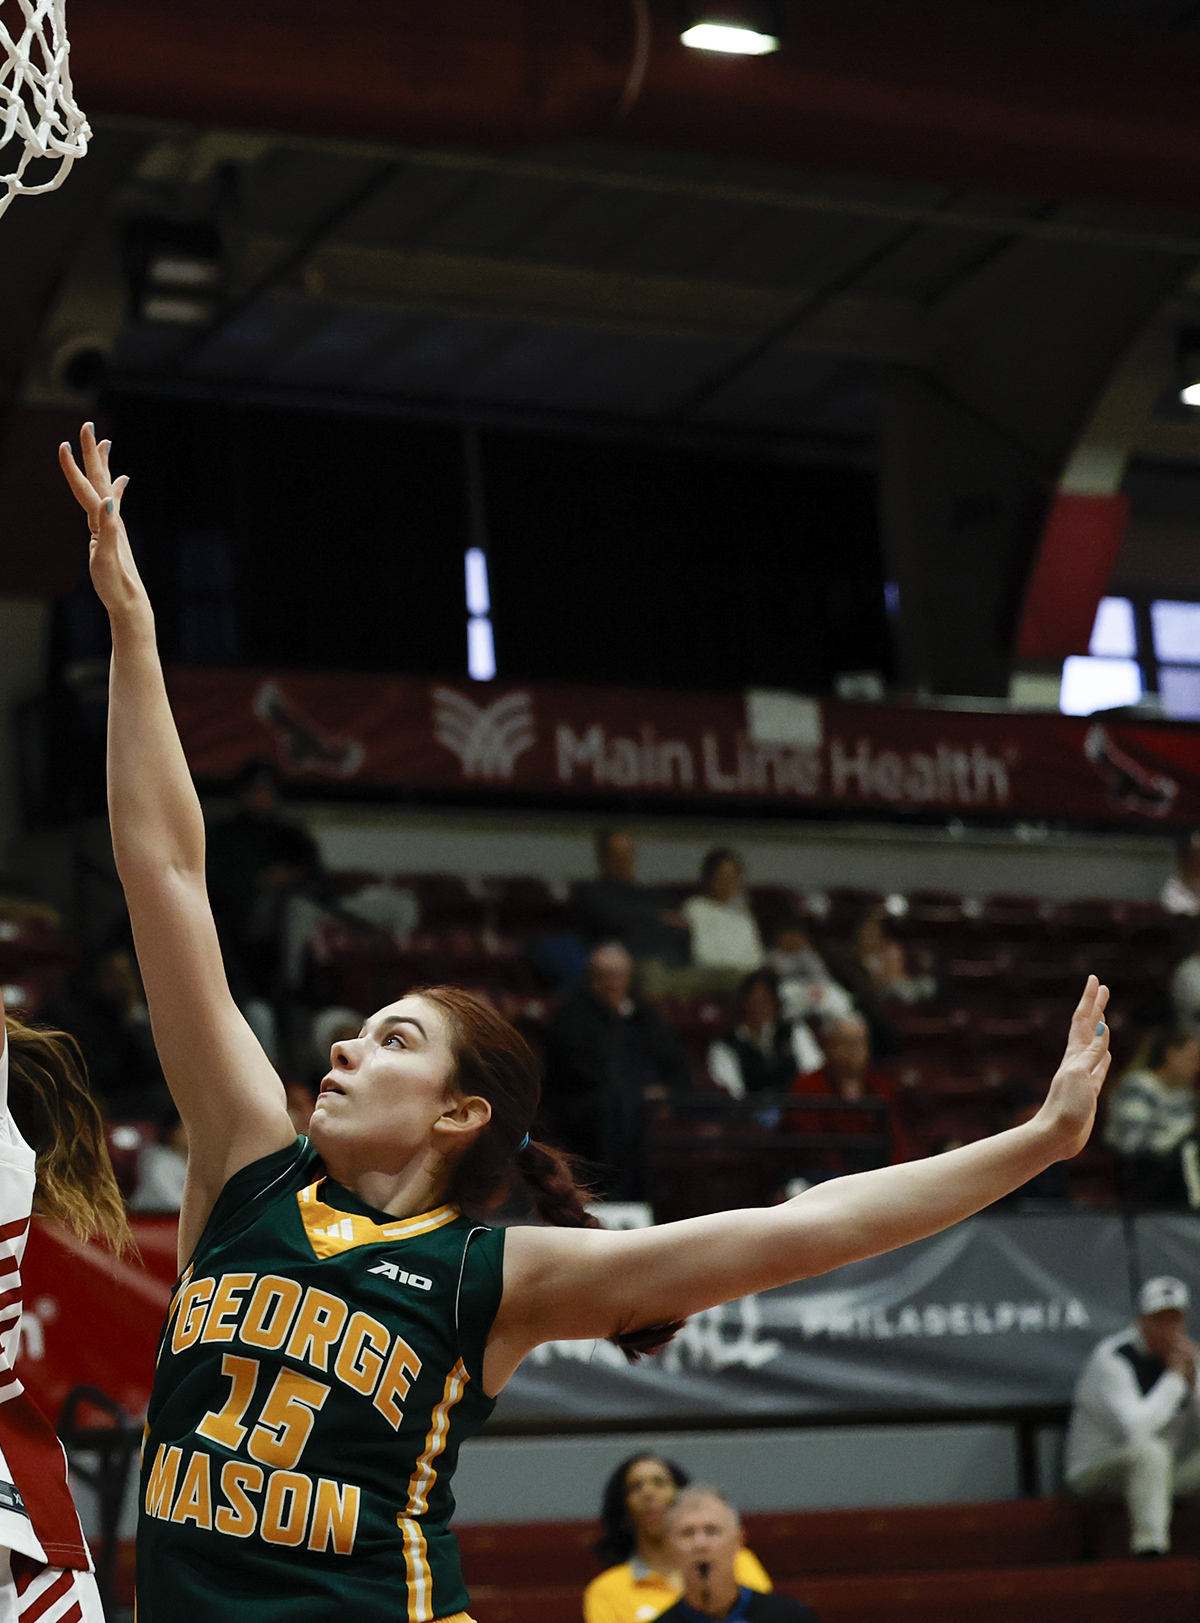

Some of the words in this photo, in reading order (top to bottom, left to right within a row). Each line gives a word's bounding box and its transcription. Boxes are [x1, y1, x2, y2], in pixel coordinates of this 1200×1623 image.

[555, 722, 694, 789] Main
[702, 732, 823, 796] Line
[830, 738, 1009, 802] Health
[366, 1259, 433, 1291] A10
[800, 1298, 1091, 1342] PHILADELPHIA
[171, 1272, 423, 1432] GEORGE
[195, 1352, 331, 1470] 15
[145, 1443, 360, 1555] MASON
